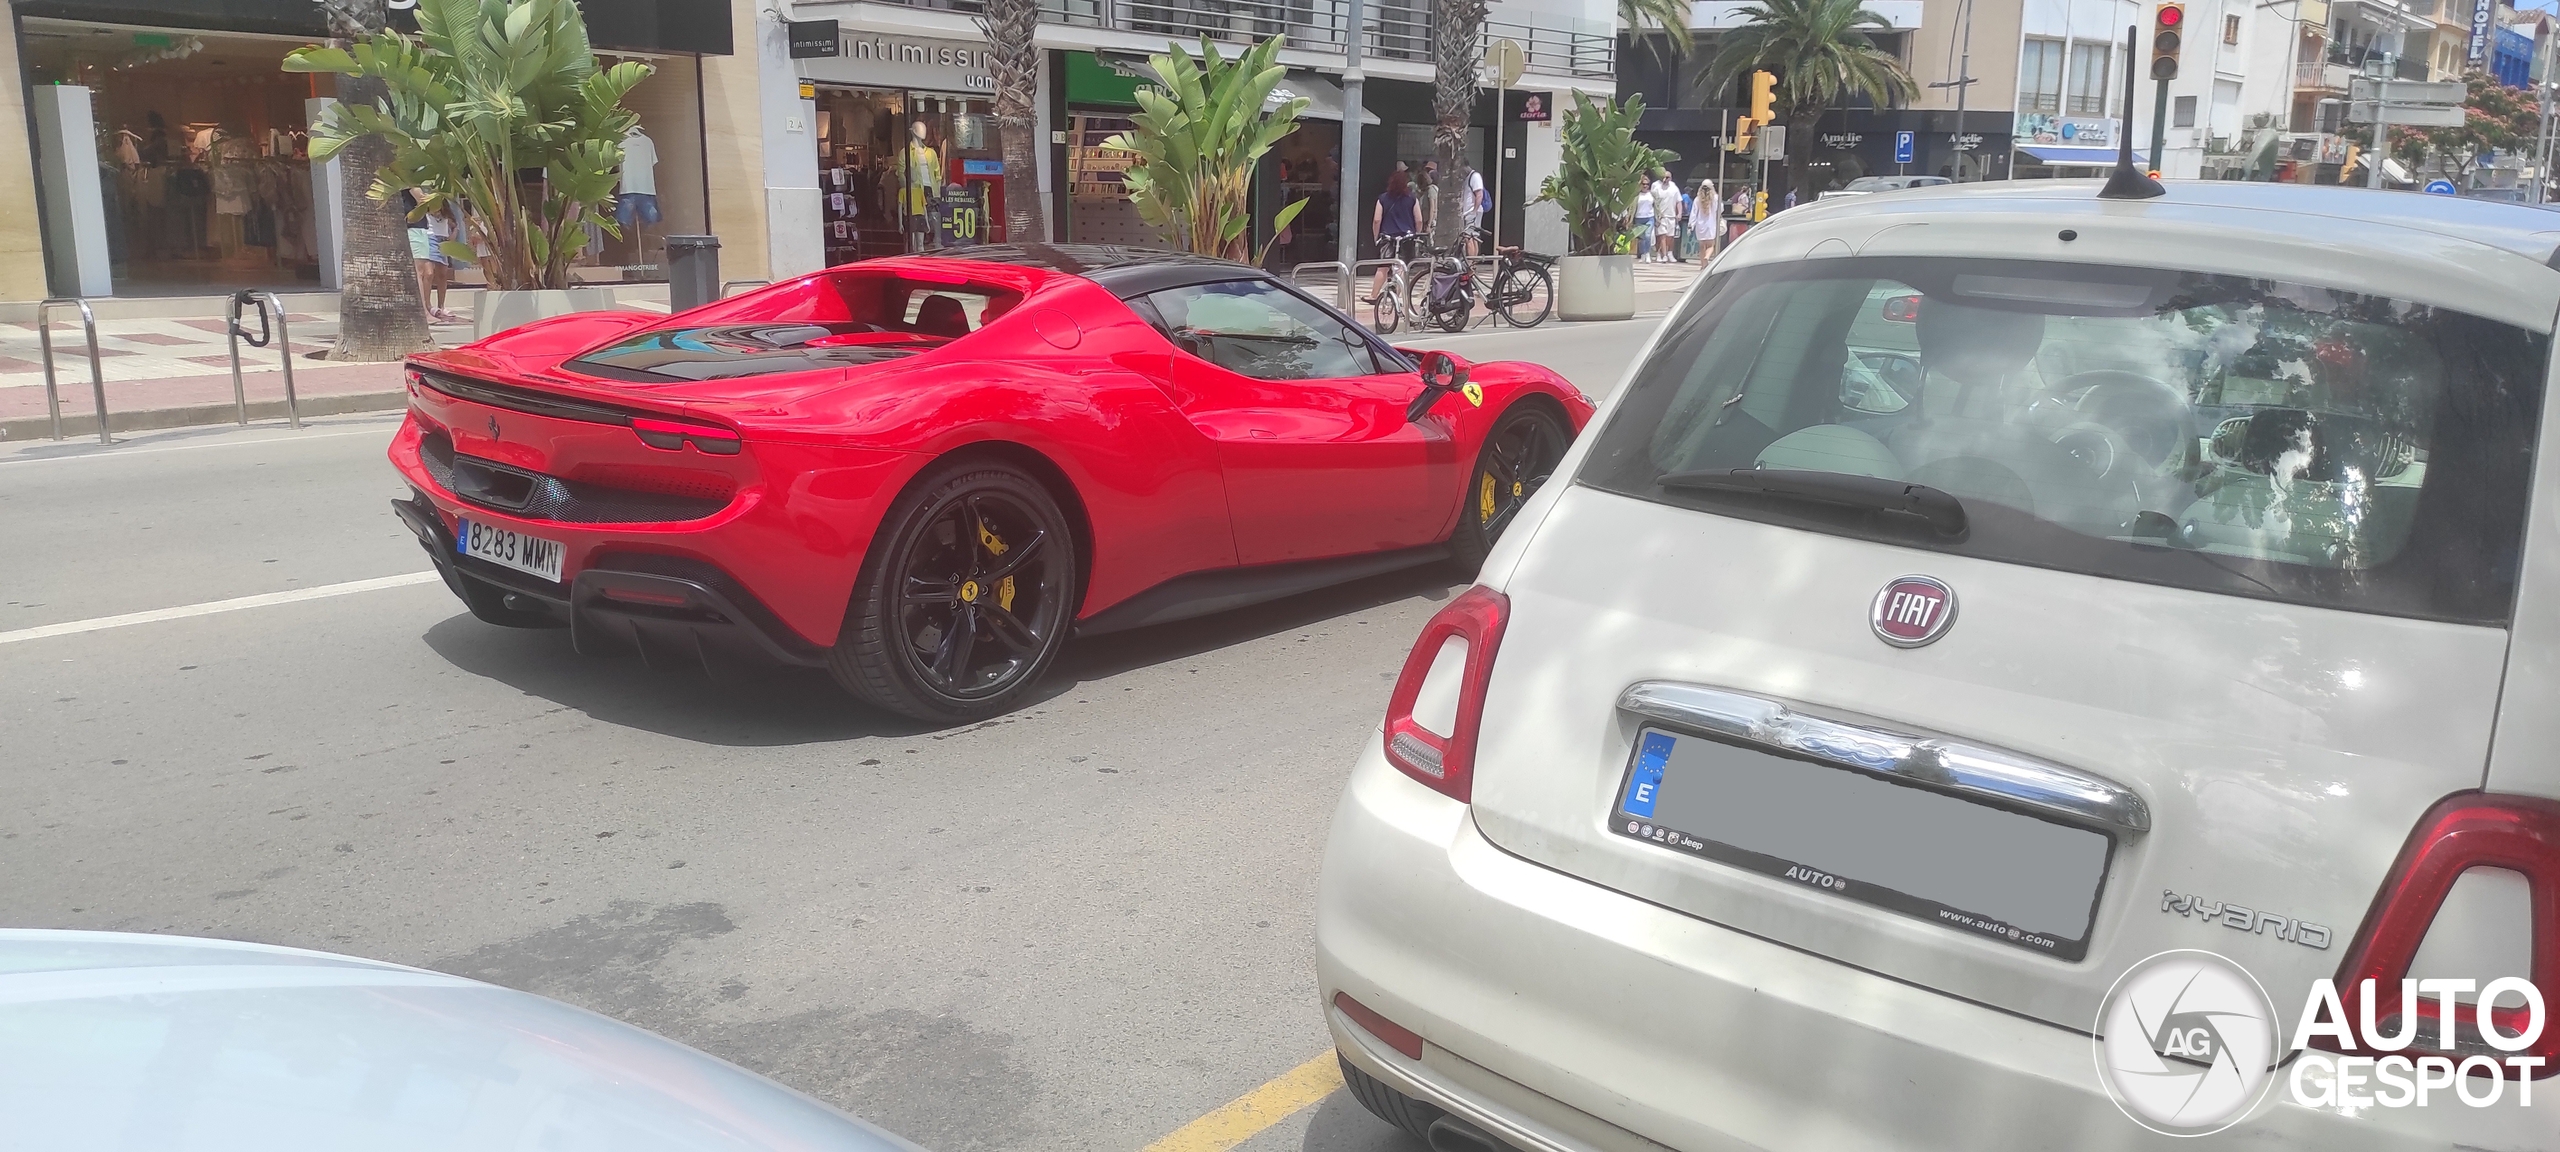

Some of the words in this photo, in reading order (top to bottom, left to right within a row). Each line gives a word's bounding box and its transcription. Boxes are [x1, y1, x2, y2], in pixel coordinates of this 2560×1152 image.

[2470, 0, 2490, 59] HOTEL
[793, 38, 834, 49] intimissimi
[1520, 111, 1547, 119] doria
[1901, 133, 1910, 149] P
[471, 522, 516, 561] 8283
[522, 535, 558, 575] MMN
[1886, 591, 1941, 628] FIAT
[1635, 782, 1654, 803] E
[1680, 836, 1704, 851] Jeep
[2161, 888, 2333, 950] HYBRID
